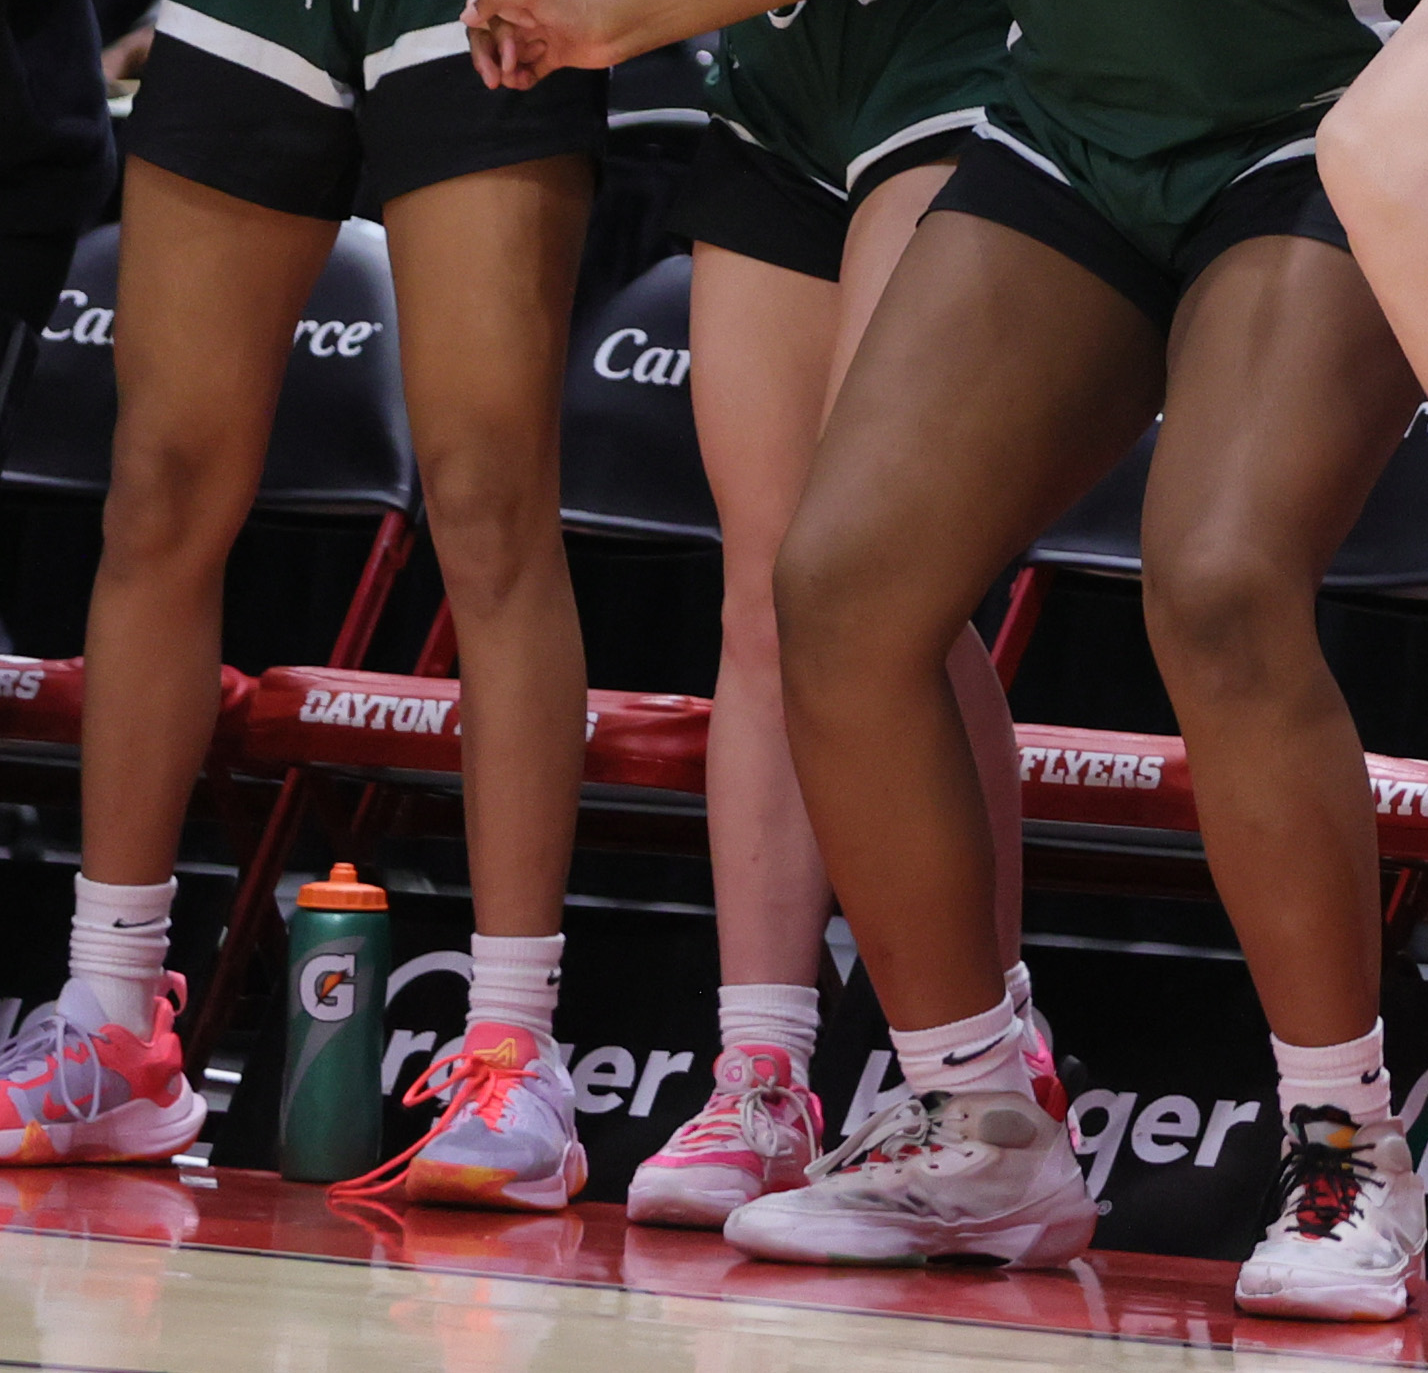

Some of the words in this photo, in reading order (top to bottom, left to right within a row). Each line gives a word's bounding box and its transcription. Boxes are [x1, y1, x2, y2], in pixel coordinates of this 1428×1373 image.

[300, 689, 453, 735] DAYTON
[1019, 746, 1165, 789] FLYERS
[301, 954, 357, 1021] G
